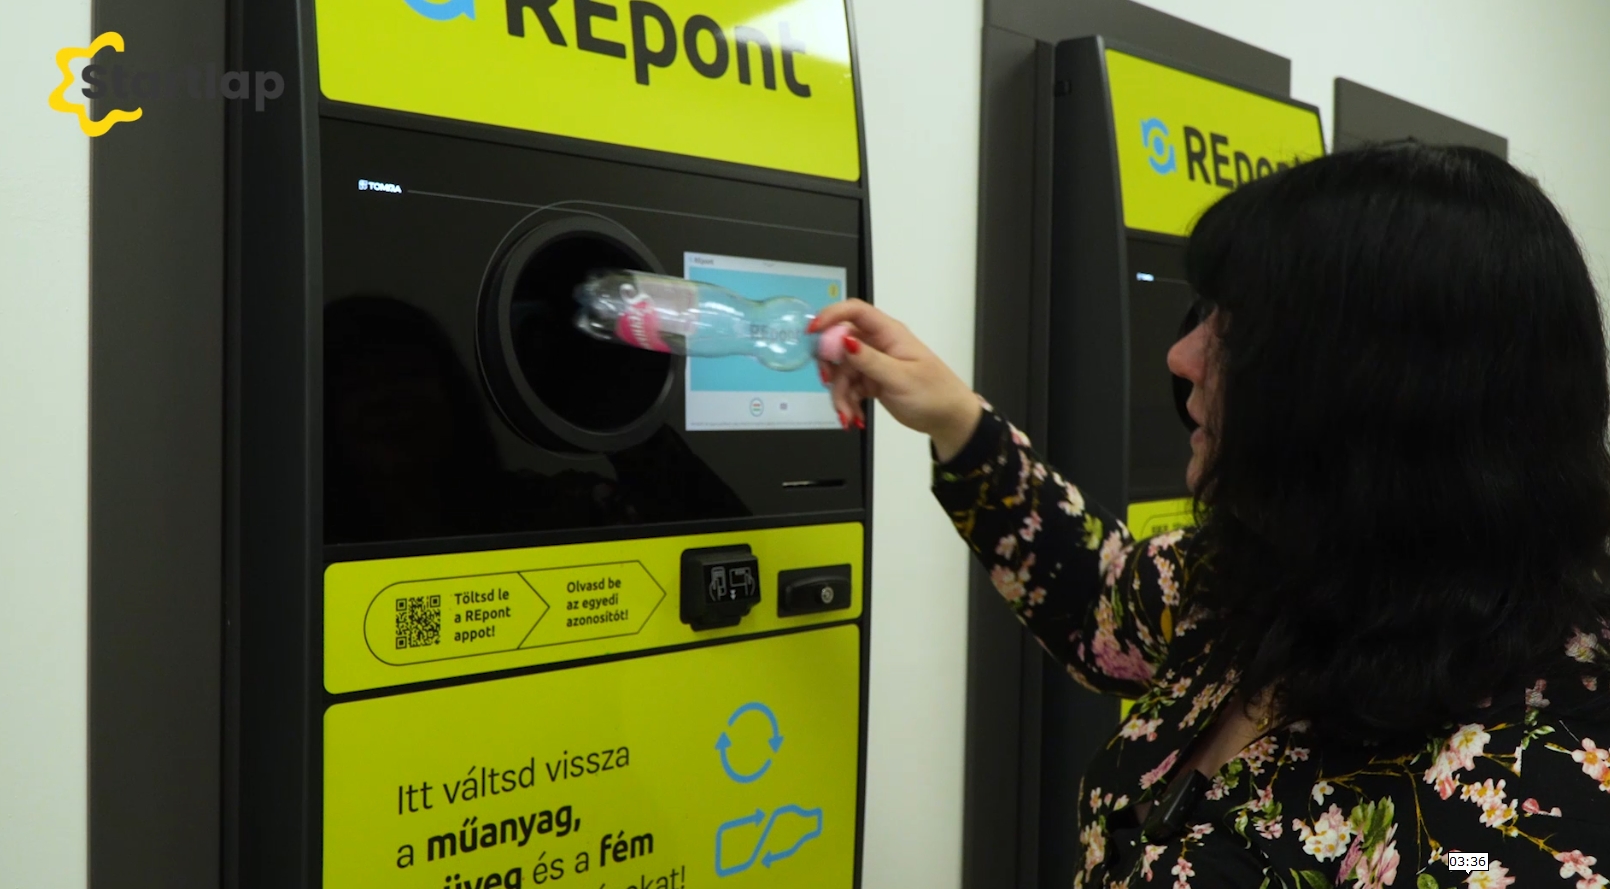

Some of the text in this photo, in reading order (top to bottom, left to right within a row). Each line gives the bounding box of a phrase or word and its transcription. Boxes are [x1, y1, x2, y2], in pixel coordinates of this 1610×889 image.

[1183, 125, 1298, 190] REpo
[567, 577, 622, 593] Olvasd be
[454, 588, 510, 605] Töltsd le
[566, 594, 619, 611] az egyedi
[454, 606, 511, 623] a REpont
[566, 609, 629, 628] azonosítót!
[454, 625, 495, 642] appot!
[398, 746, 630, 815] Itt váltsd vissza
[396, 805, 581, 869] a műanyag,
[532, 851, 565, 885] és
[574, 851, 589, 874] a
[599, 830, 654, 867] fém
